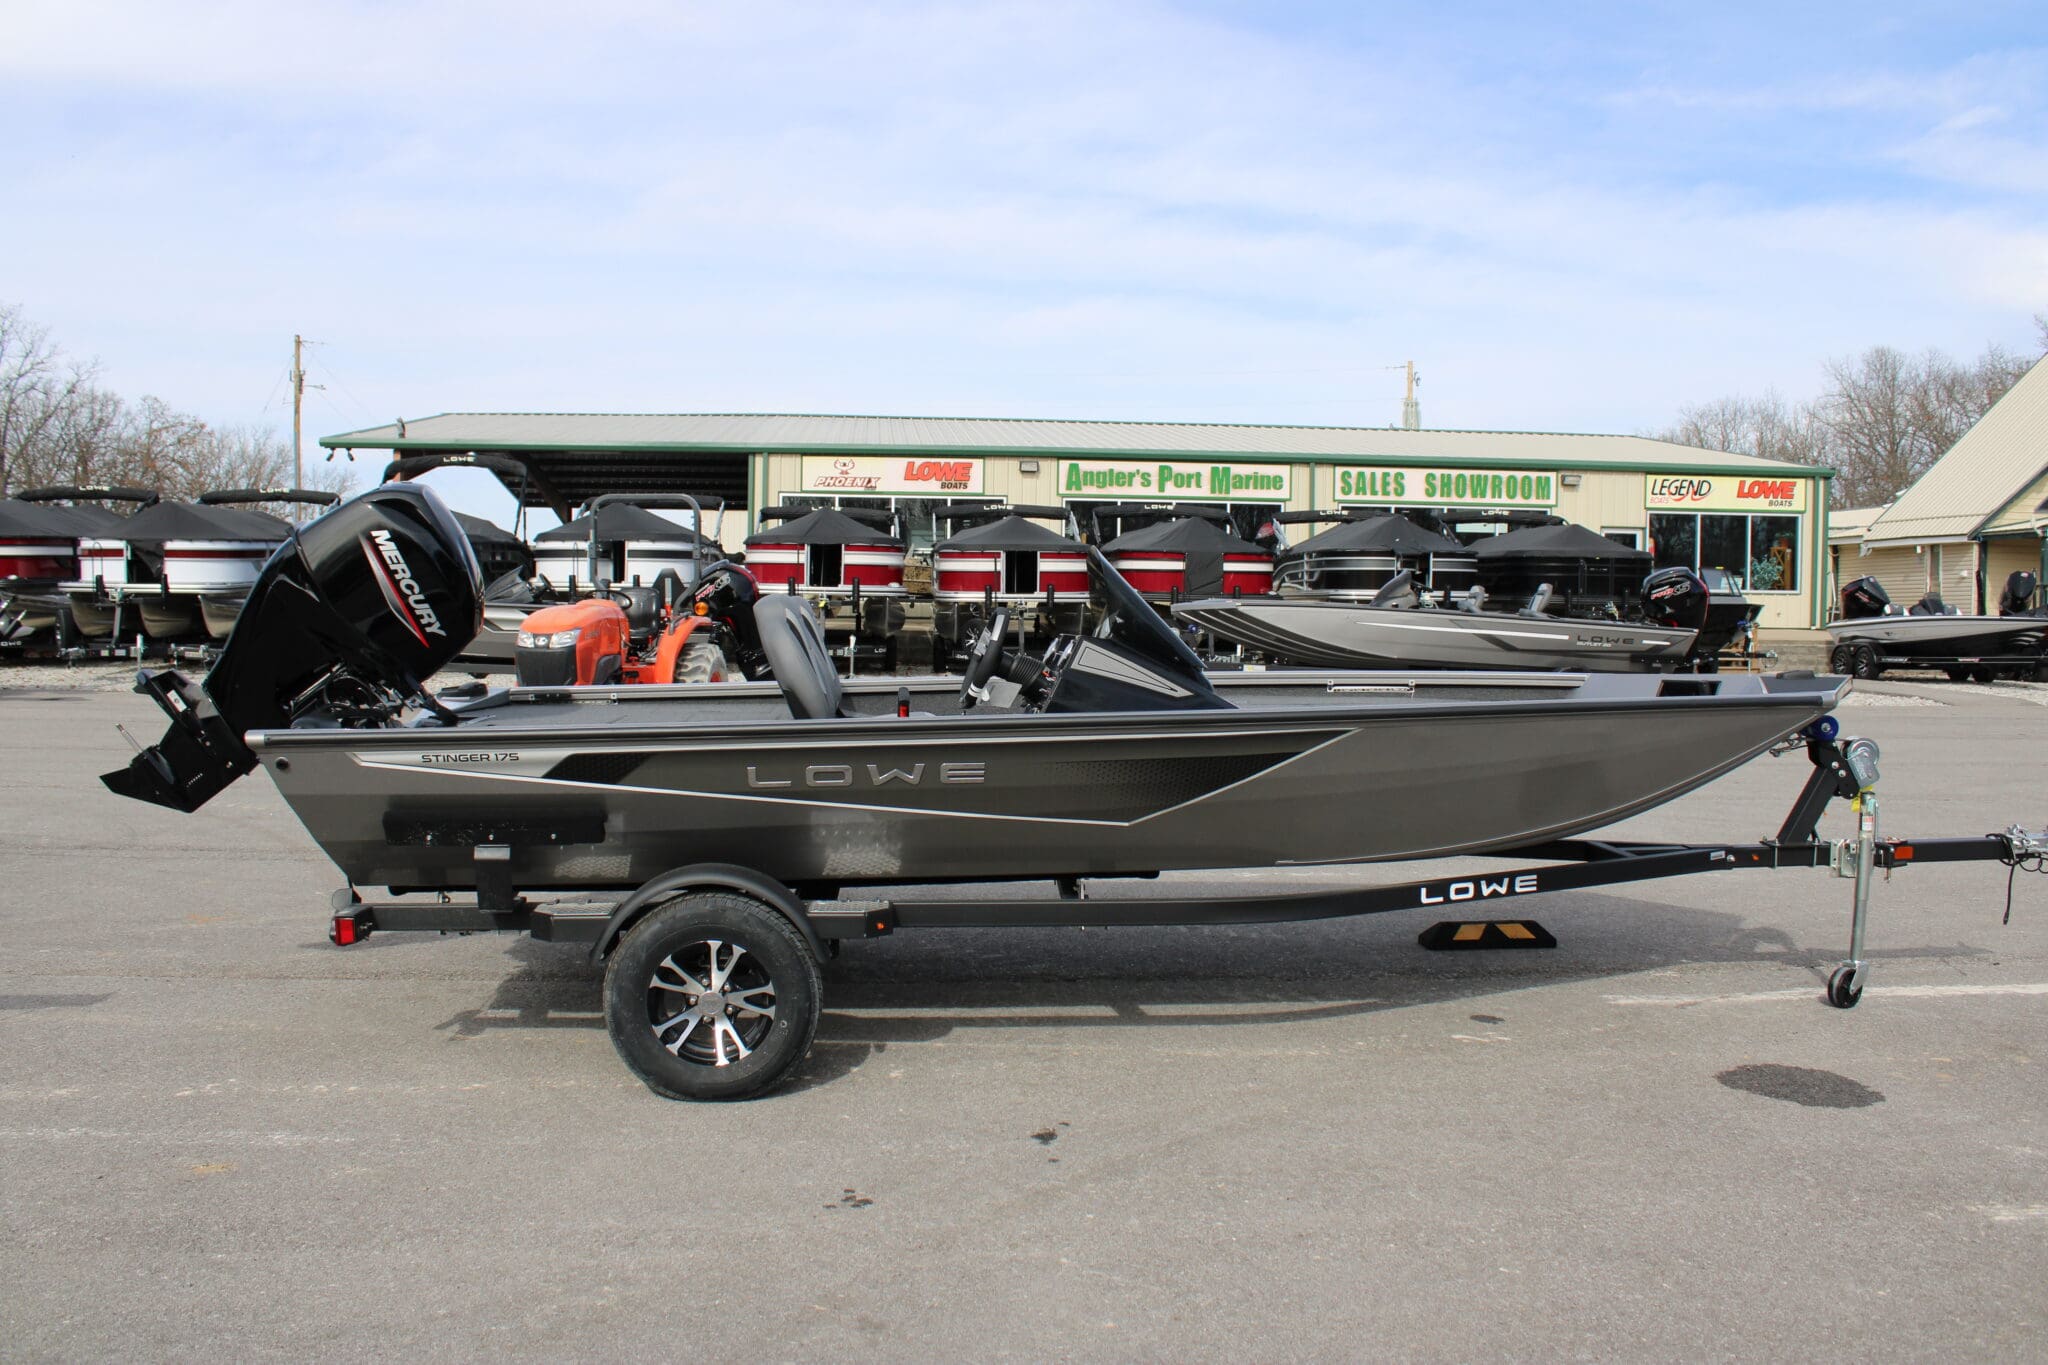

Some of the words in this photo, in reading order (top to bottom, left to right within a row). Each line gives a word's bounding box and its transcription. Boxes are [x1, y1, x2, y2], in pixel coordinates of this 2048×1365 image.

[904, 461, 973, 482] LOWE
[1065, 463, 1152, 491] Angler's
[1158, 464, 1202, 492] Port
[1210, 466, 1283, 494] Marine
[813, 476, 881, 488] PHOENIX
[940, 481, 968, 490] BOATS
[1340, 470, 1405, 497] SALES
[1425, 472, 1551, 500] SHOWROOM
[1651, 479, 1712, 497] LEGEND
[1736, 480, 1797, 499] LOWE
[1650, 496, 1669, 504] BOATS
[1768, 499, 1793, 507] BOATS
[370, 529, 448, 637] MERCURY
[1578, 635, 1635, 645] LOWE
[421, 753, 490, 763] STINGER
[494, 752, 520, 762] 175
[746, 762, 986, 788] LOWE
[1420, 873, 1538, 905] LOWE
